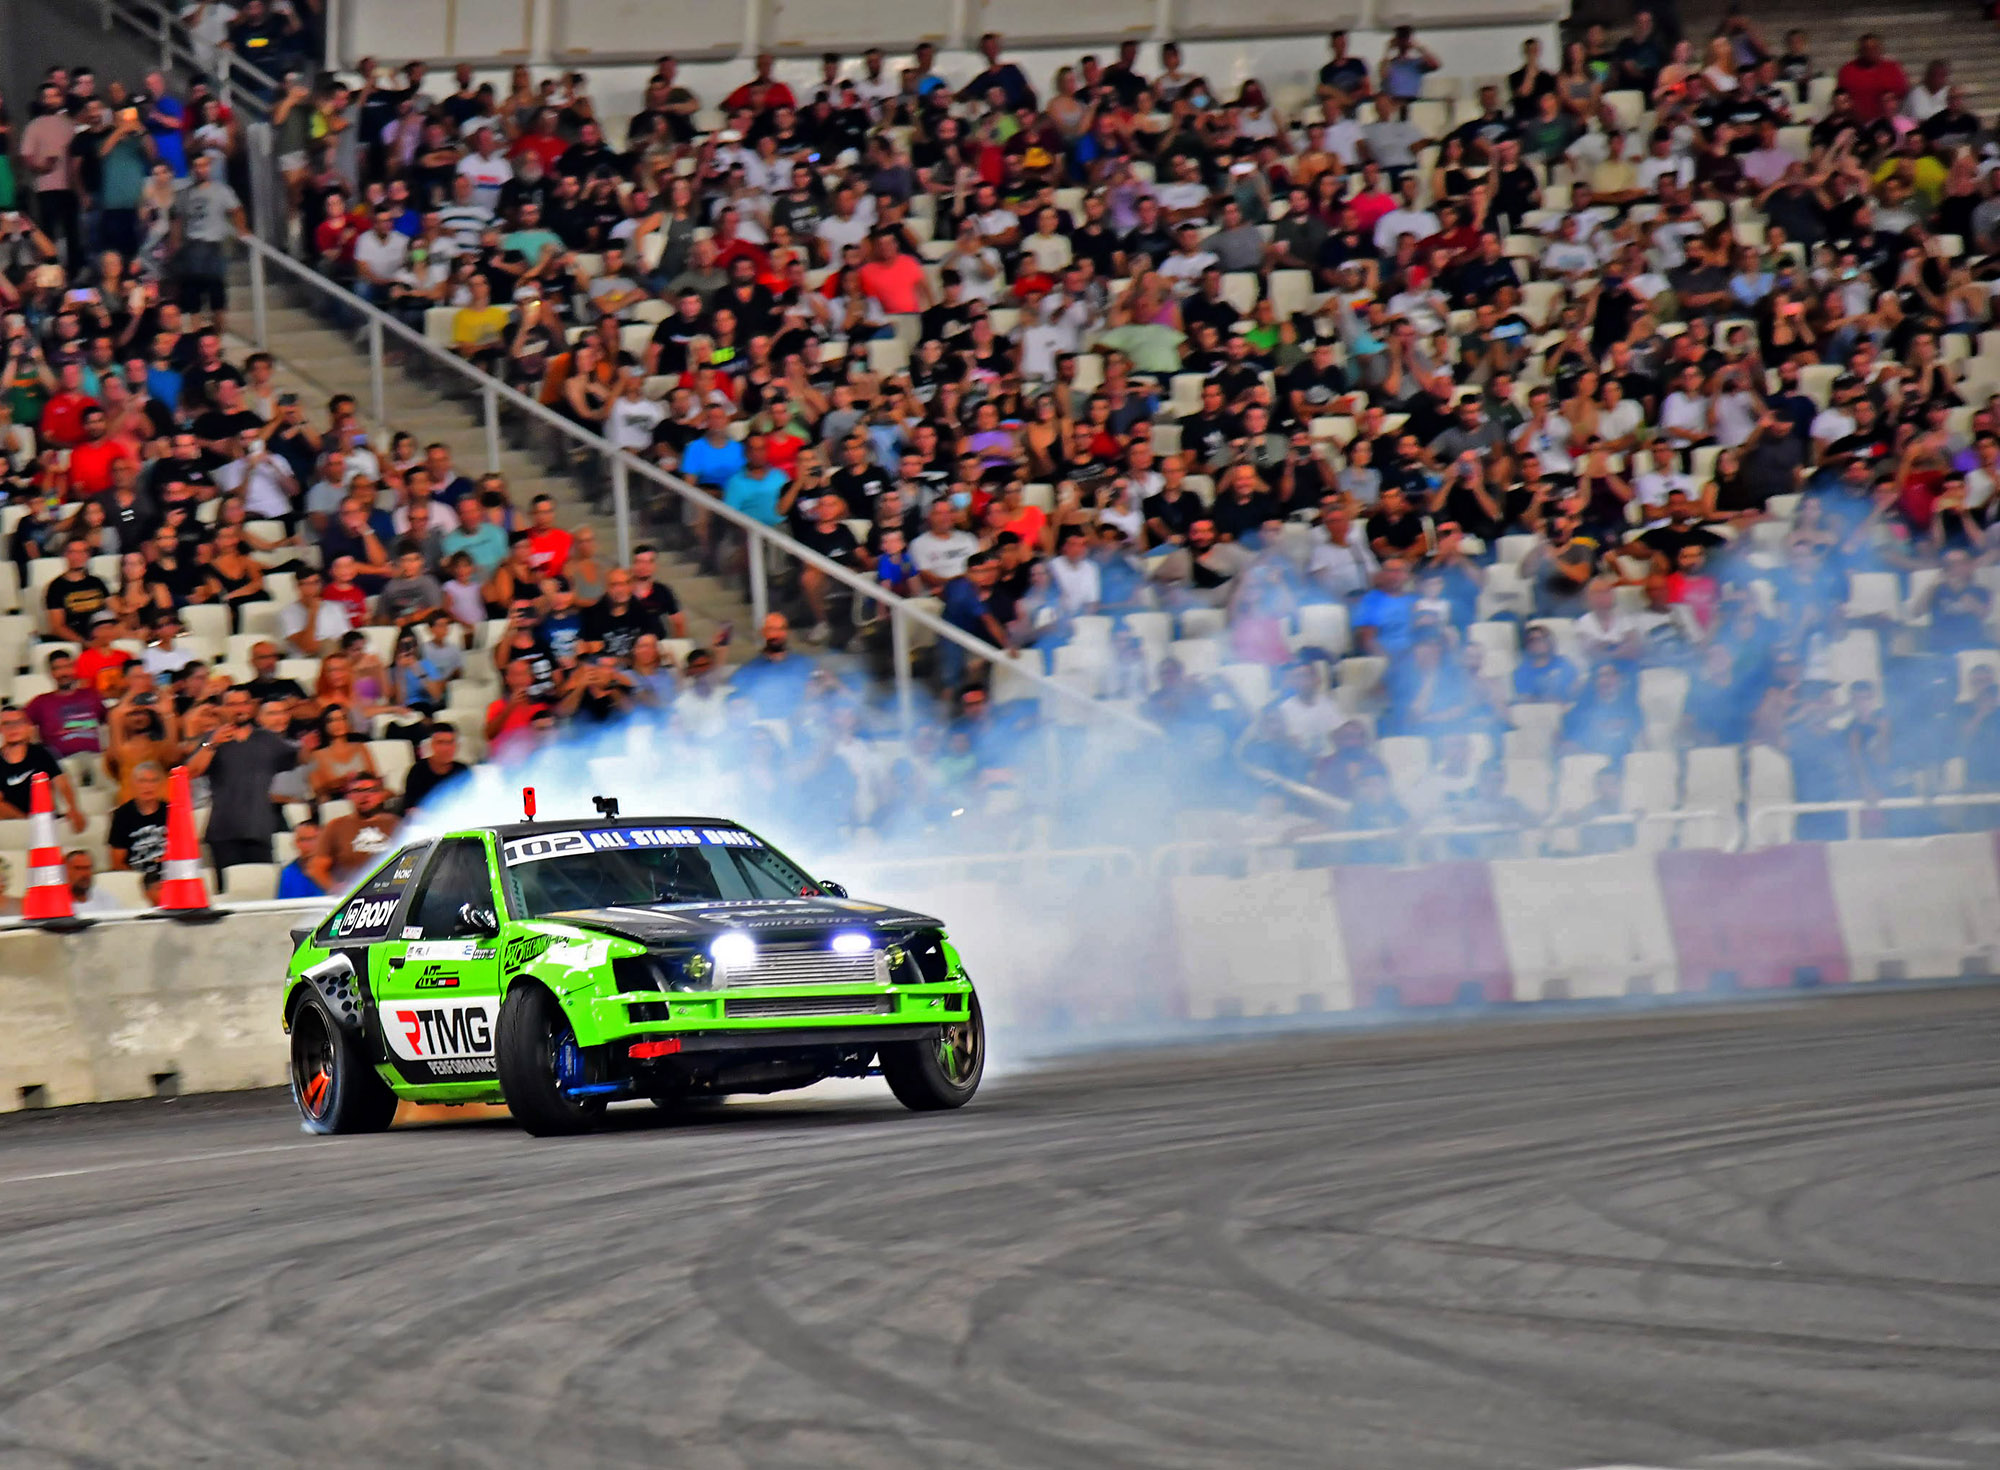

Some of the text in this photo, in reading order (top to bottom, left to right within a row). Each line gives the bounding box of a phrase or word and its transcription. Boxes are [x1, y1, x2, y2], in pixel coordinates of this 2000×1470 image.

[504, 836, 584, 861] 102
[590, 831, 630, 848] ALL
[630, 829, 701, 846] STARS
[355, 899, 400, 929] BODY
[396, 1007, 492, 1056] RTMG
[427, 1058, 497, 1075] PERFORMANC
